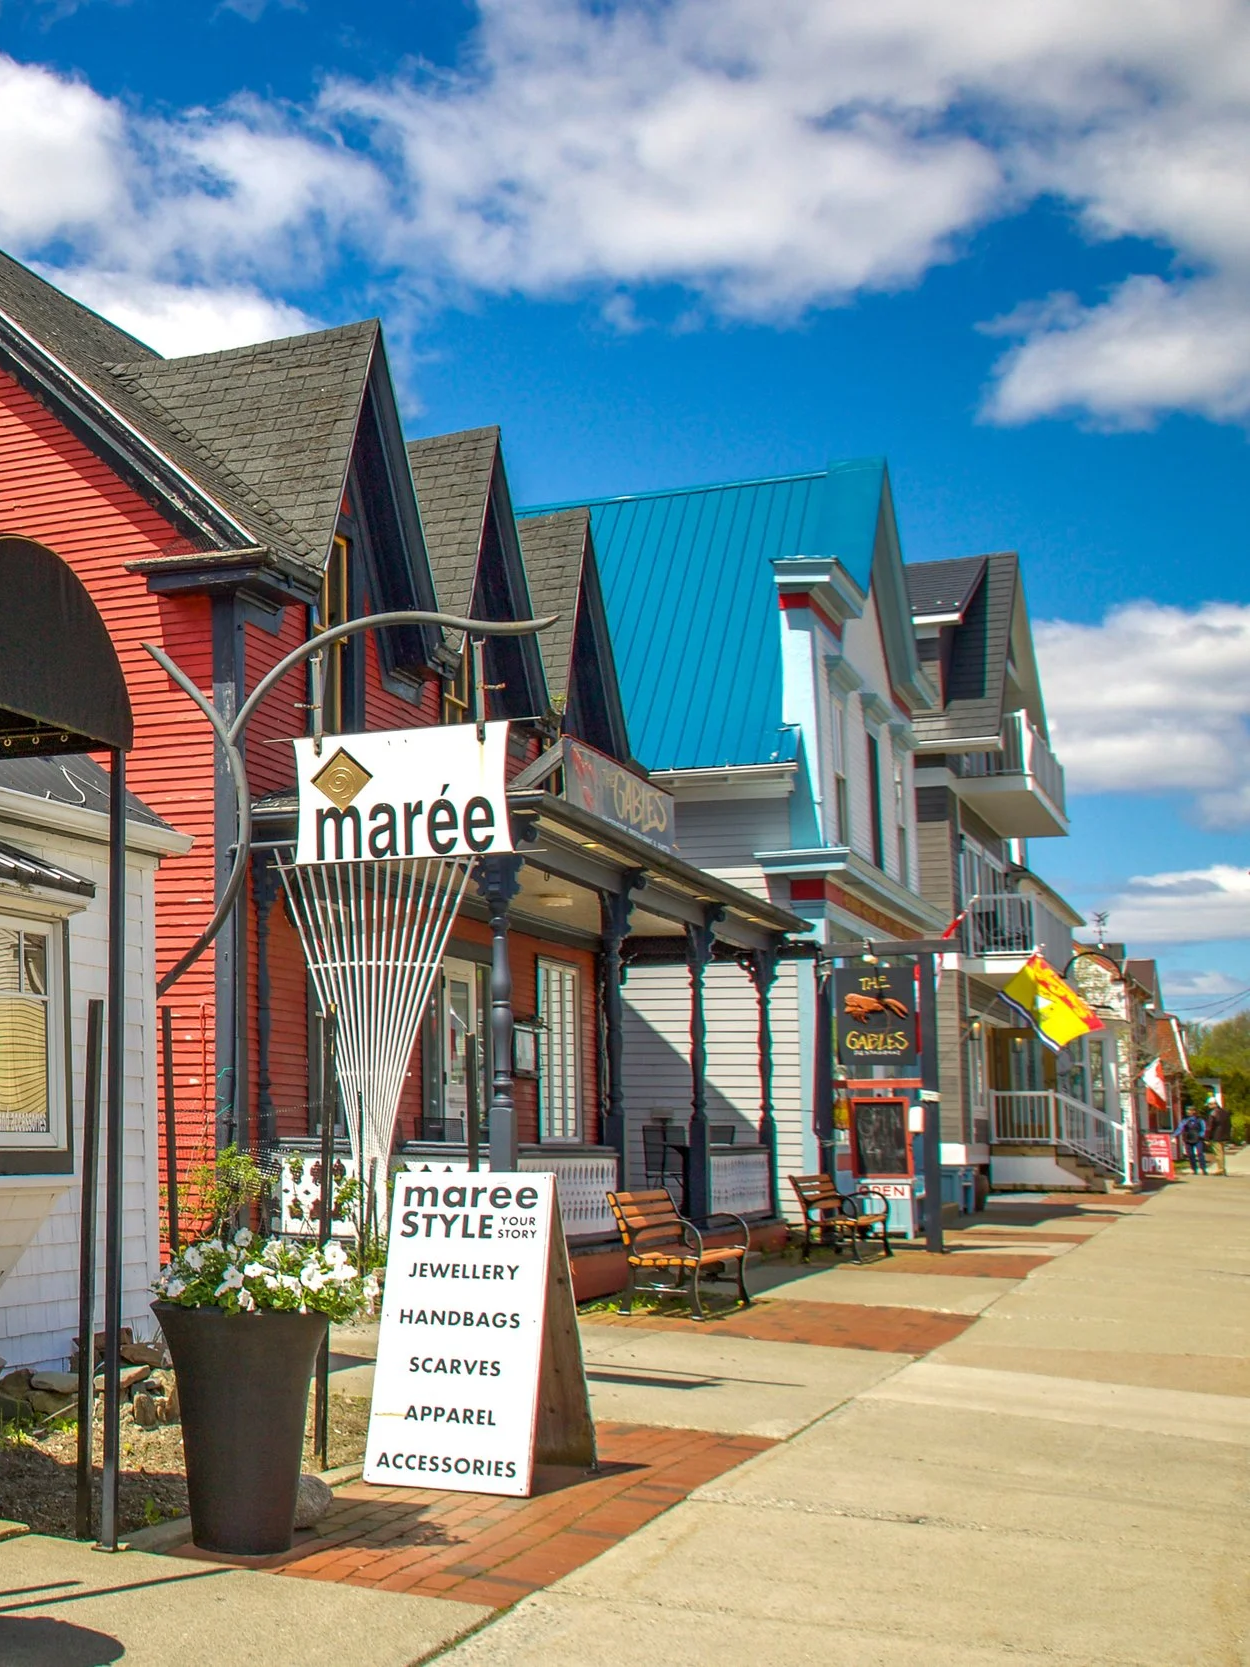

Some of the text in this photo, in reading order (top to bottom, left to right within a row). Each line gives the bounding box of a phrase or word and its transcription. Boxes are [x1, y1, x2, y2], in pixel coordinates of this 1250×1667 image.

[613, 770, 668, 833] GABLES
[315, 783, 495, 861] marée
[858, 975, 892, 991] THE
[846, 1030, 910, 1051] GABLES
[1142, 1156, 1169, 1173] OPEN
[858, 1185, 906, 1197] OPEN
[400, 1210, 537, 1239] STYLE YOUR
[497, 1229, 538, 1239] STORY
[408, 1262, 520, 1281] JEWELLERY
[400, 1308, 521, 1329] HANDBAGS
[409, 1356, 501, 1377] SCARVES
[404, 1405, 497, 1426] APPAREL
[376, 1451, 517, 1479] ACCESSORIES
